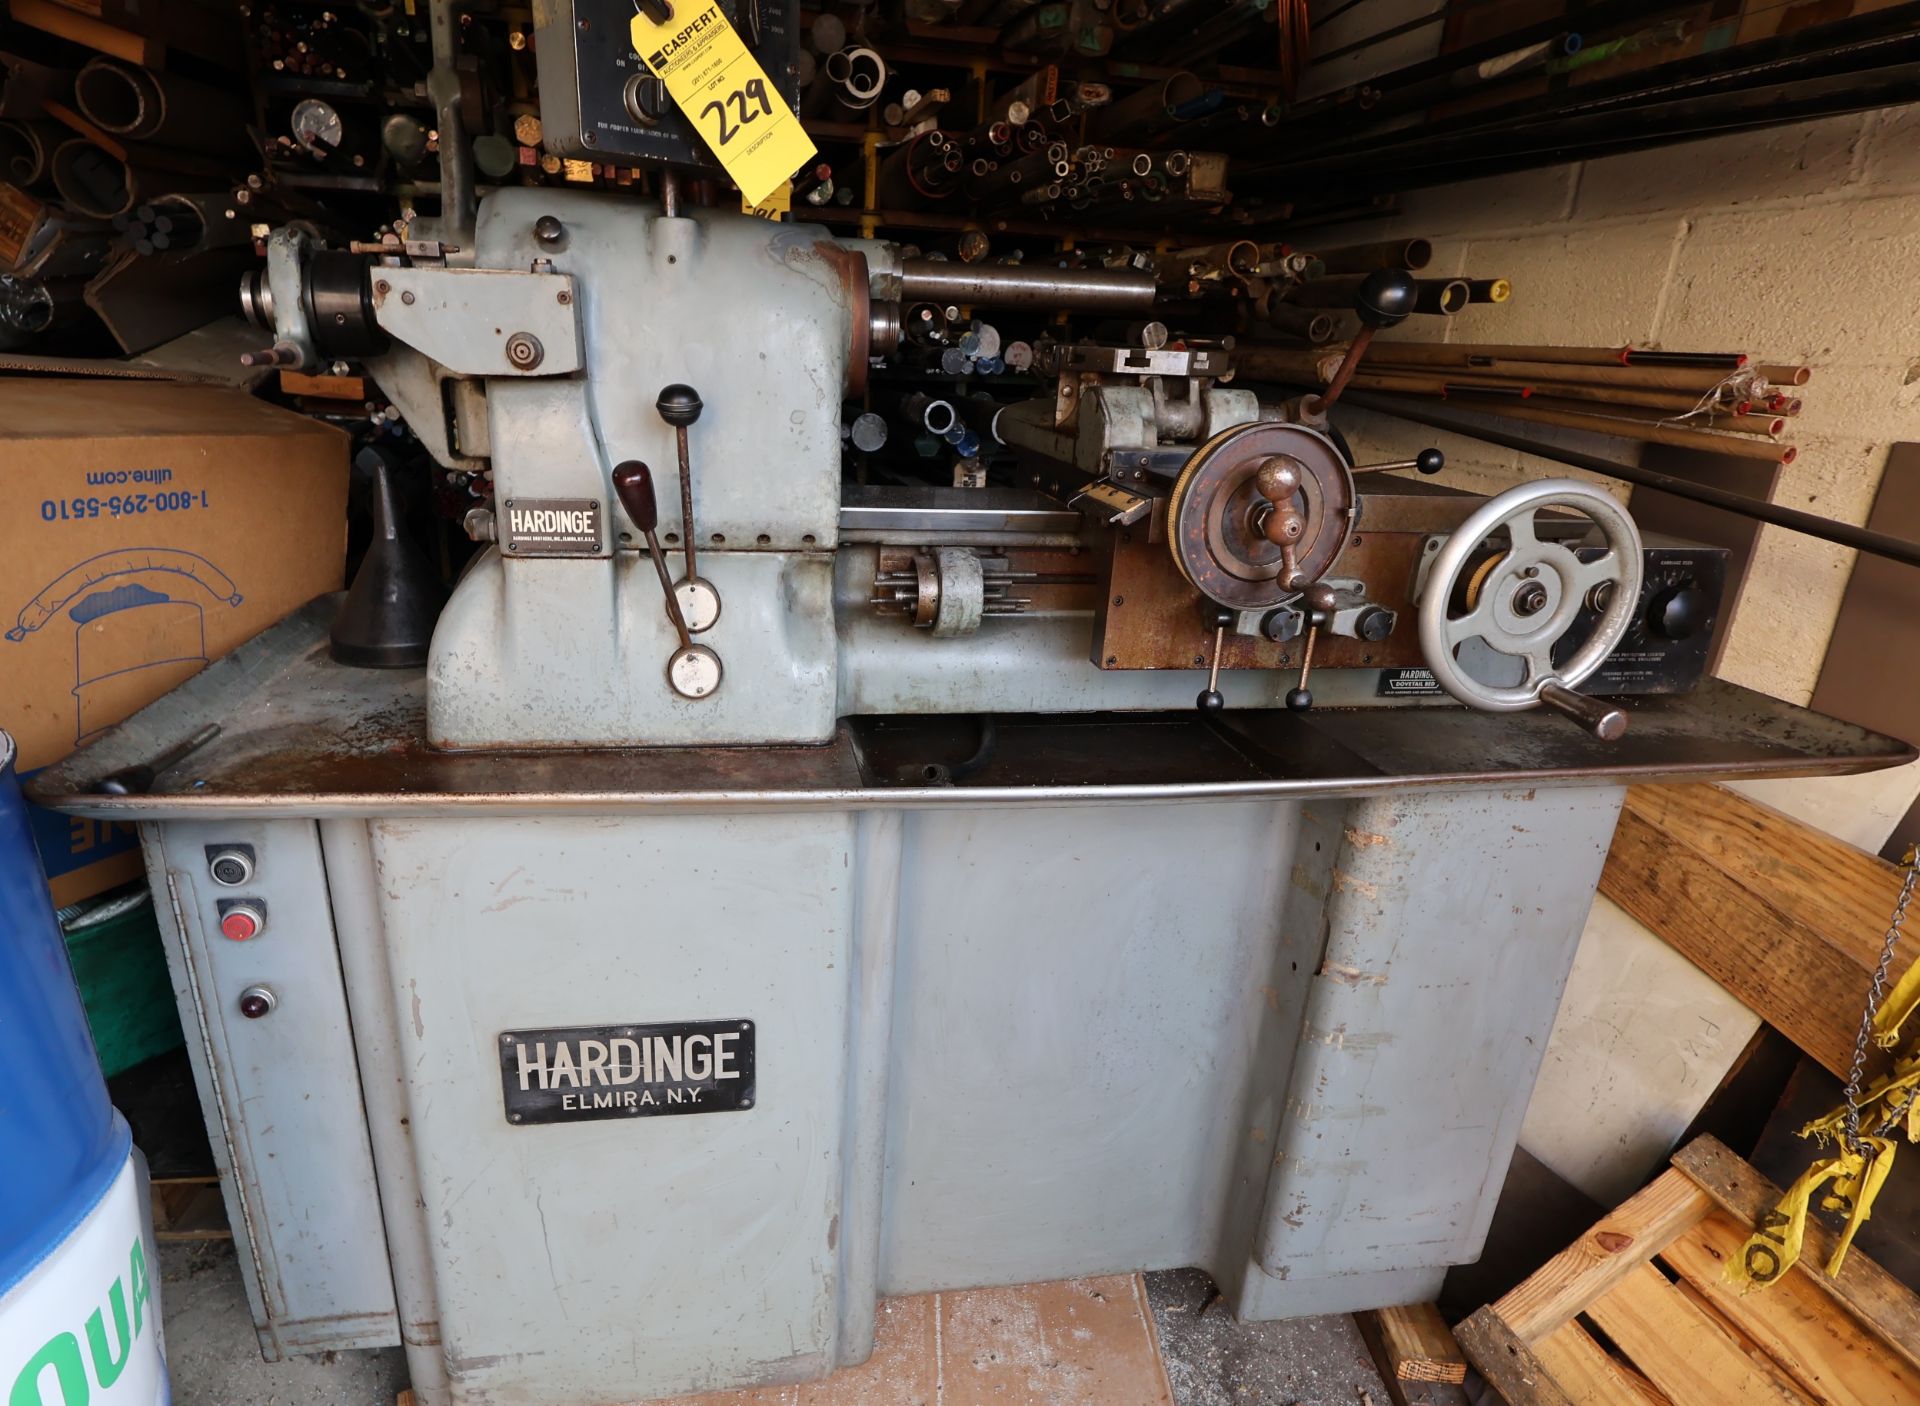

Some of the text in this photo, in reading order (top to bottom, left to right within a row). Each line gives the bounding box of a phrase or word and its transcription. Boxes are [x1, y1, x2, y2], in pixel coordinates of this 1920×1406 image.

[662, 6, 719, 57] CASPERT
[662, 49, 695, 75] AUCTIONEERS
[697, 23, 726, 48] APPRAISERS
[616, 58, 626, 68] ON
[708, 79, 720, 91] LOT
[699, 78, 773, 146] 229
[746, 131, 774, 156] DESCRIPTION
[86, 468, 173, 487] uline.com
[41, 490, 209, 521] 1-800-295-5510
[510, 509, 595, 533] HARDINGE
[1400, 670, 1435, 679] HARDING
[516, 1032, 740, 1091] HARDINGE
[667, 1087, 702, 1104] N.Y.
